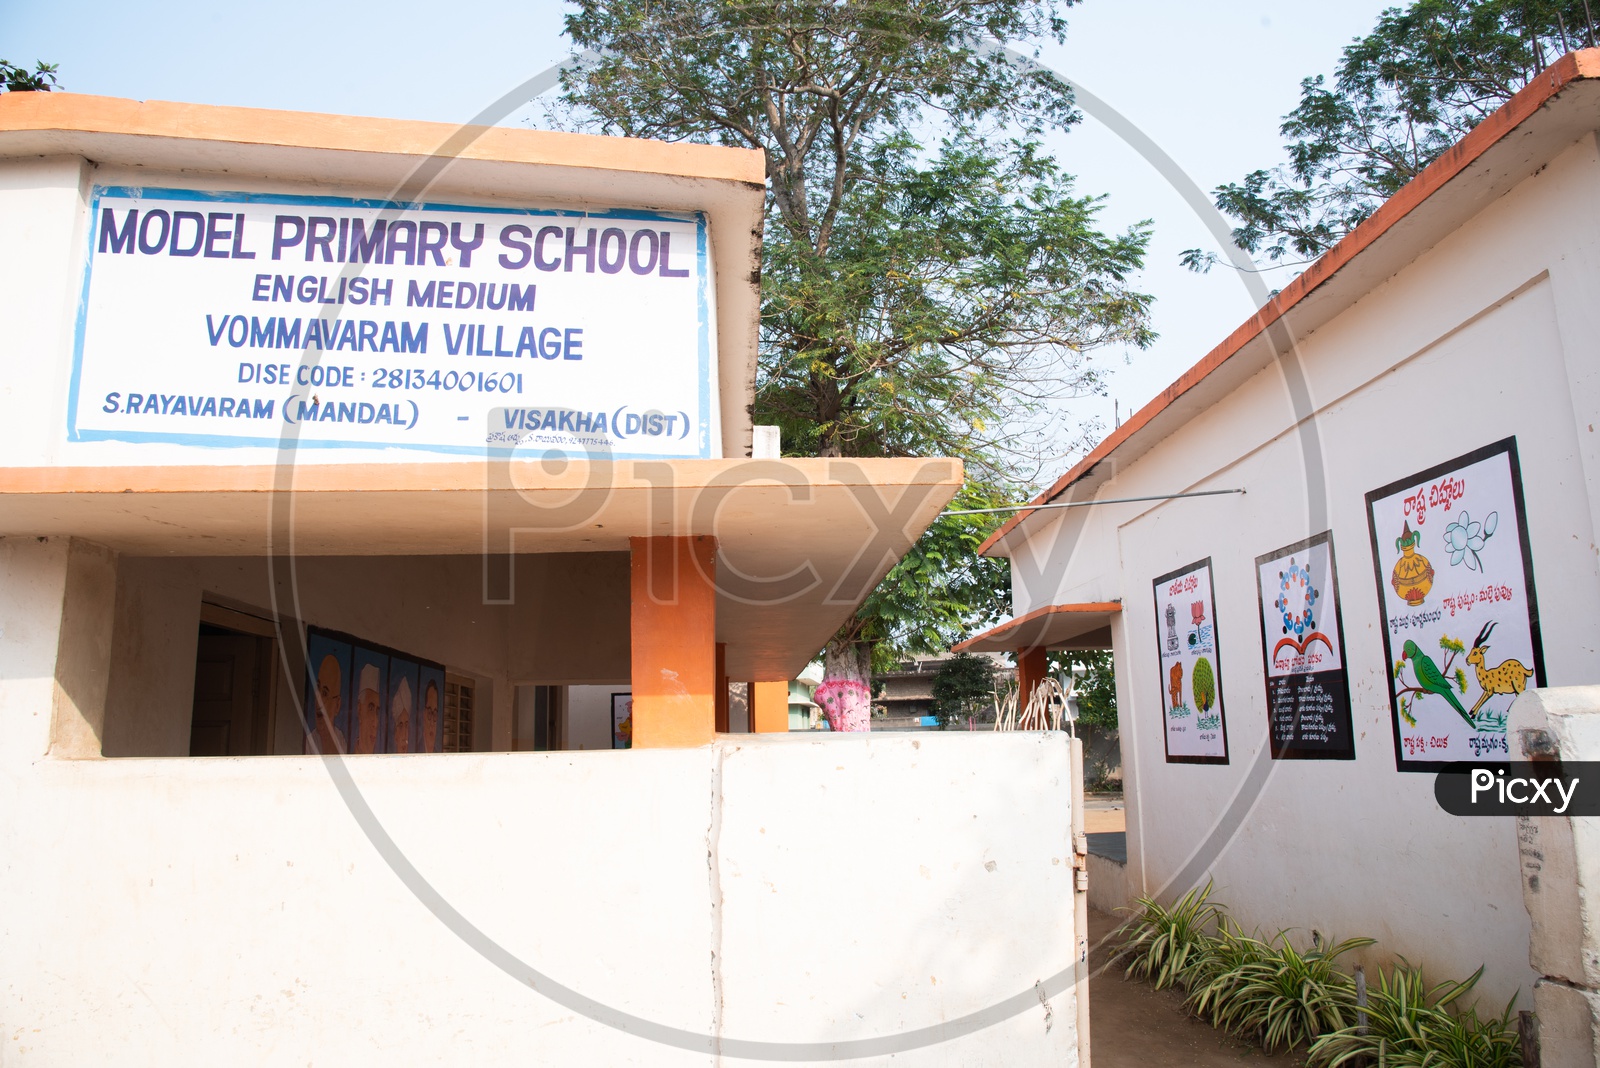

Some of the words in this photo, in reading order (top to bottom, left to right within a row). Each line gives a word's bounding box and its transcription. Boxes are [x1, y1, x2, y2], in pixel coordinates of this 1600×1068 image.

[98, 207, 256, 260] MODEL
[271, 214, 485, 268] PRIMARY
[498, 223, 690, 278] SCHOOL
[252, 274, 393, 306] ENGLISH
[406, 279, 537, 312] MEDIUM
[205, 314, 429, 354] VOMMAVARAM
[443, 323, 583, 361] VILLAGE
[238, 362, 291, 385] DISE
[371, 368, 523, 394] 28134001601
[102, 392, 275, 420] S.RAYAVARAM
[282, 394, 419, 430] (MANDAL)
